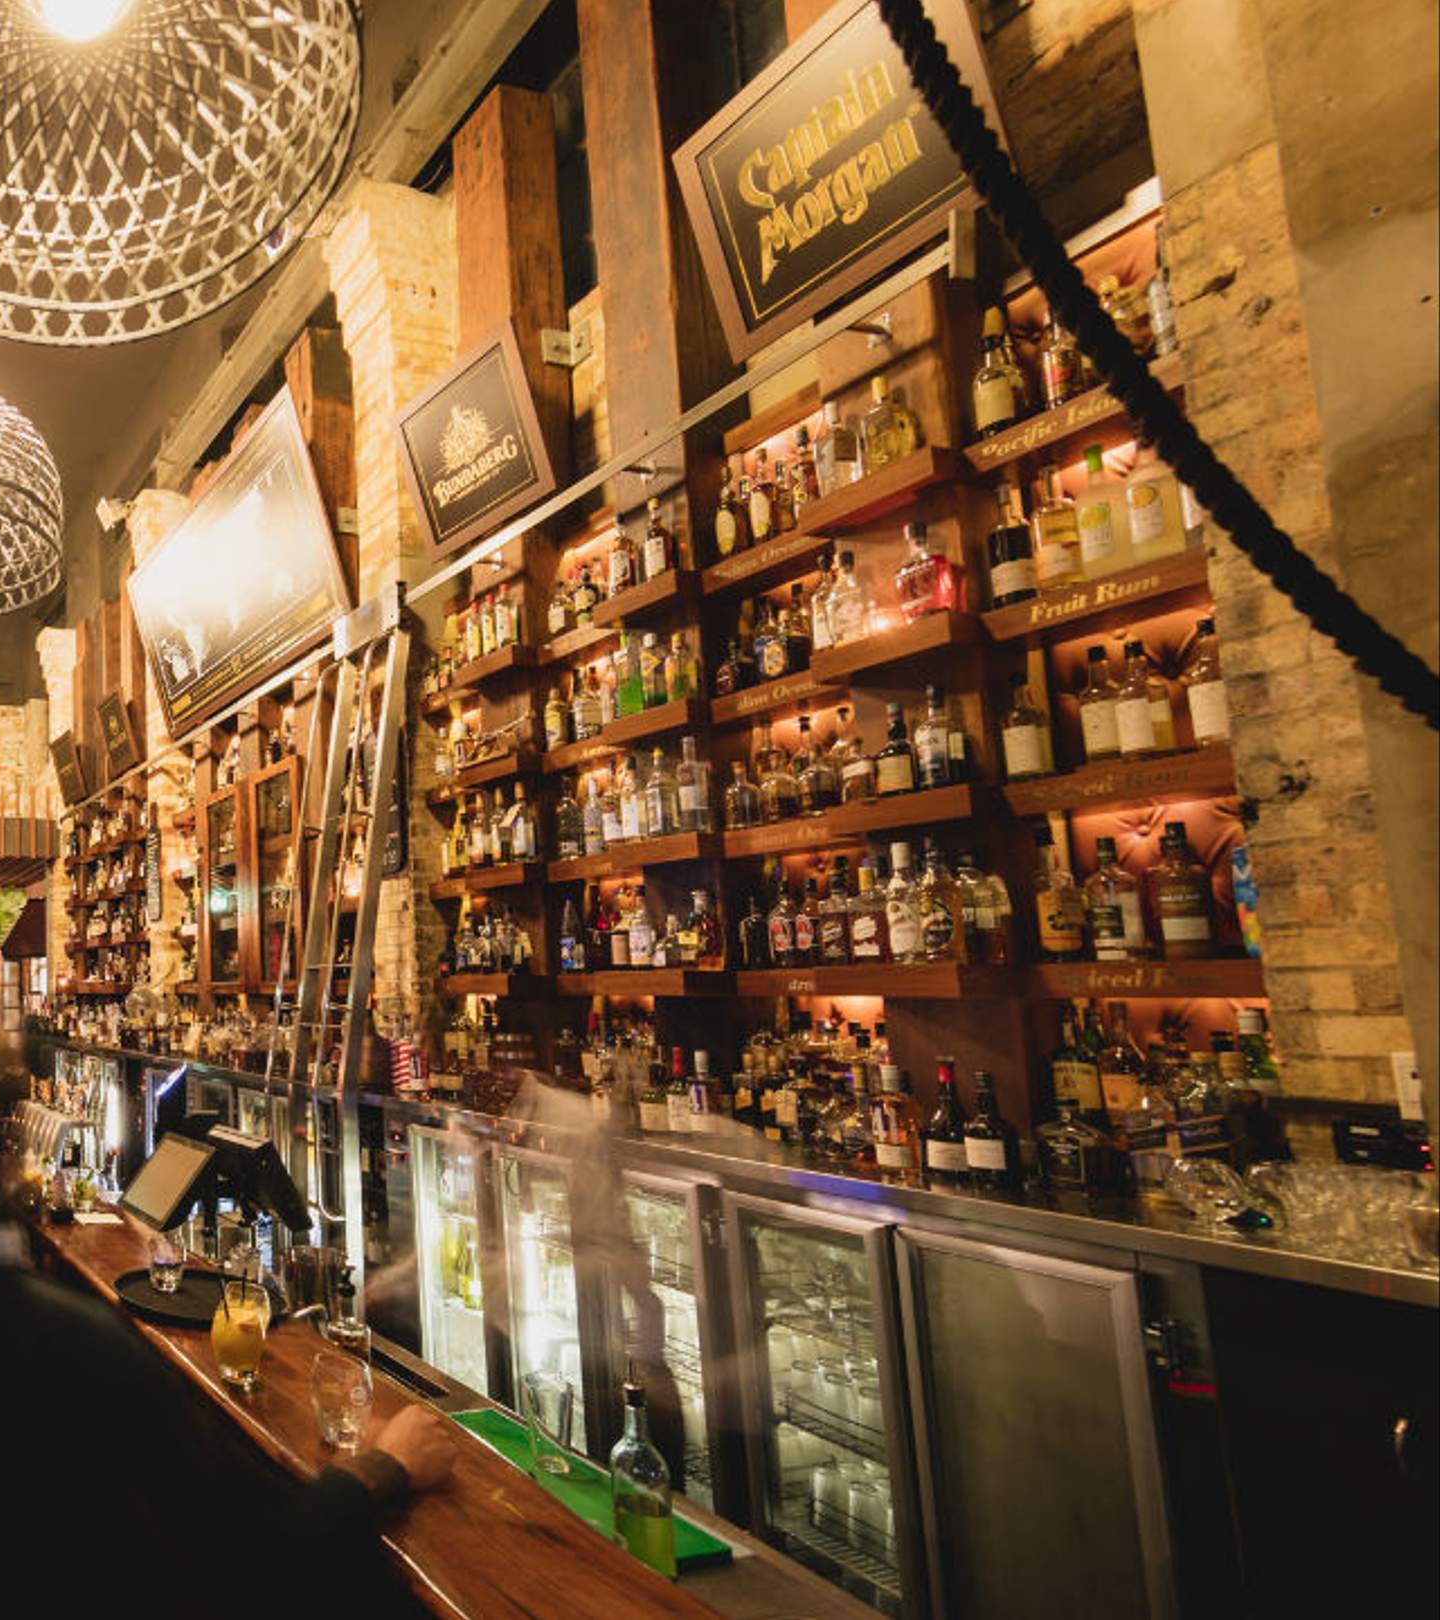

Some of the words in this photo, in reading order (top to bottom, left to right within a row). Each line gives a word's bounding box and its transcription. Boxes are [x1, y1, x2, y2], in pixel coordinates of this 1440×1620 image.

[738, 61, 897, 209] Captain
[758, 117, 922, 286] Morgan
[1066, 396, 1118, 426] Isla
[1029, 593, 1088, 624] Fruit
[1095, 575, 1160, 605] Rum
